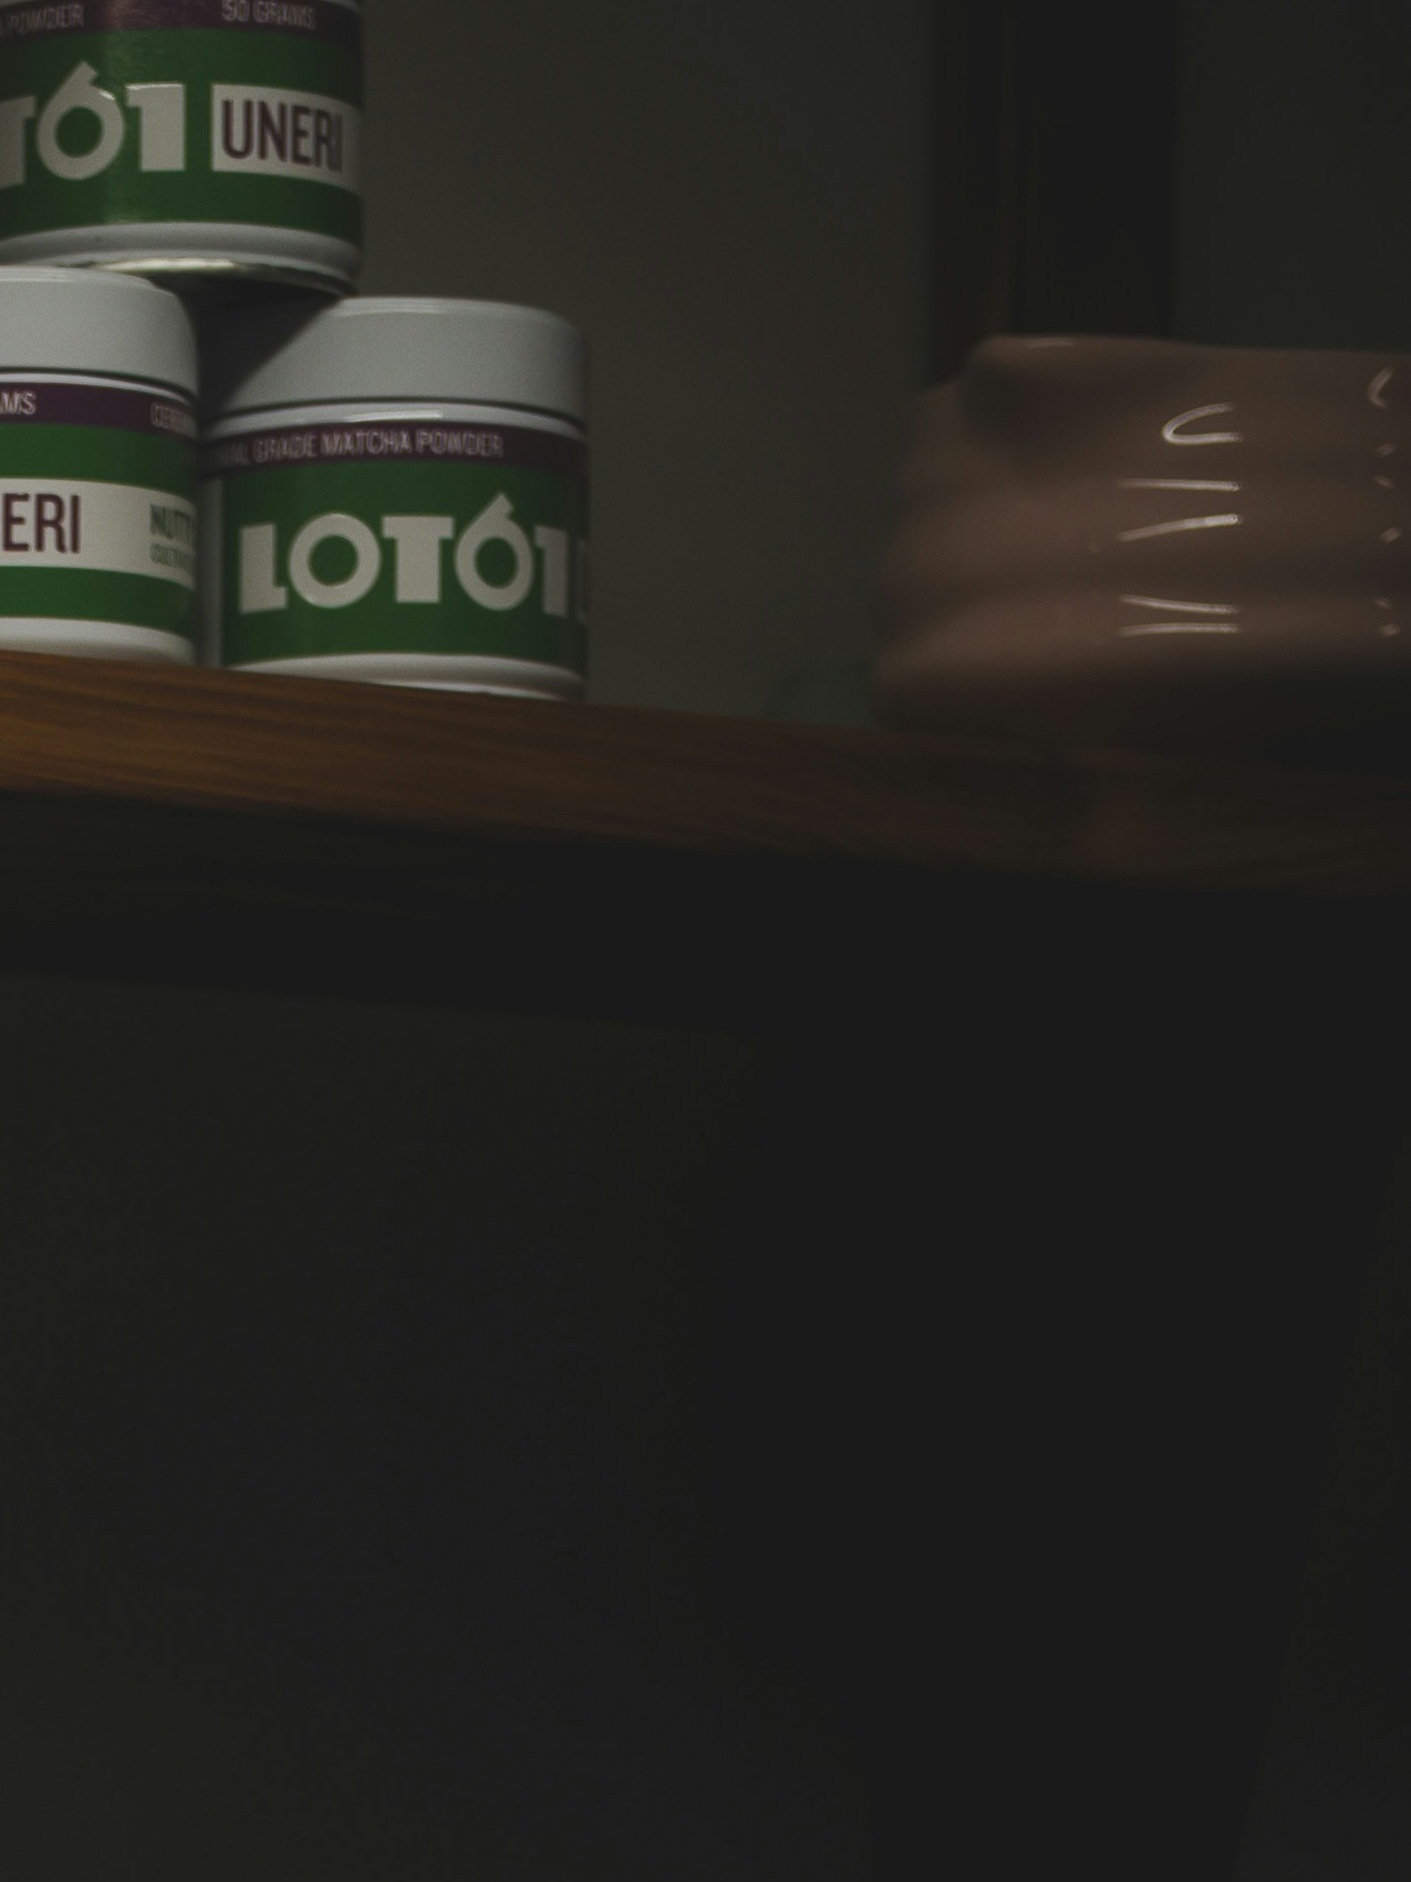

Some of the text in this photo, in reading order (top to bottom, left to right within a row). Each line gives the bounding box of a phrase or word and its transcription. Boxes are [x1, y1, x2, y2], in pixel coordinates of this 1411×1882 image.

[253, 0, 317, 30] GRAMS
[221, 98, 344, 173] UNERI
[252, 432, 318, 463] GRADE
[320, 430, 411, 459] MATCHA
[418, 431, 504, 459] POWDER
